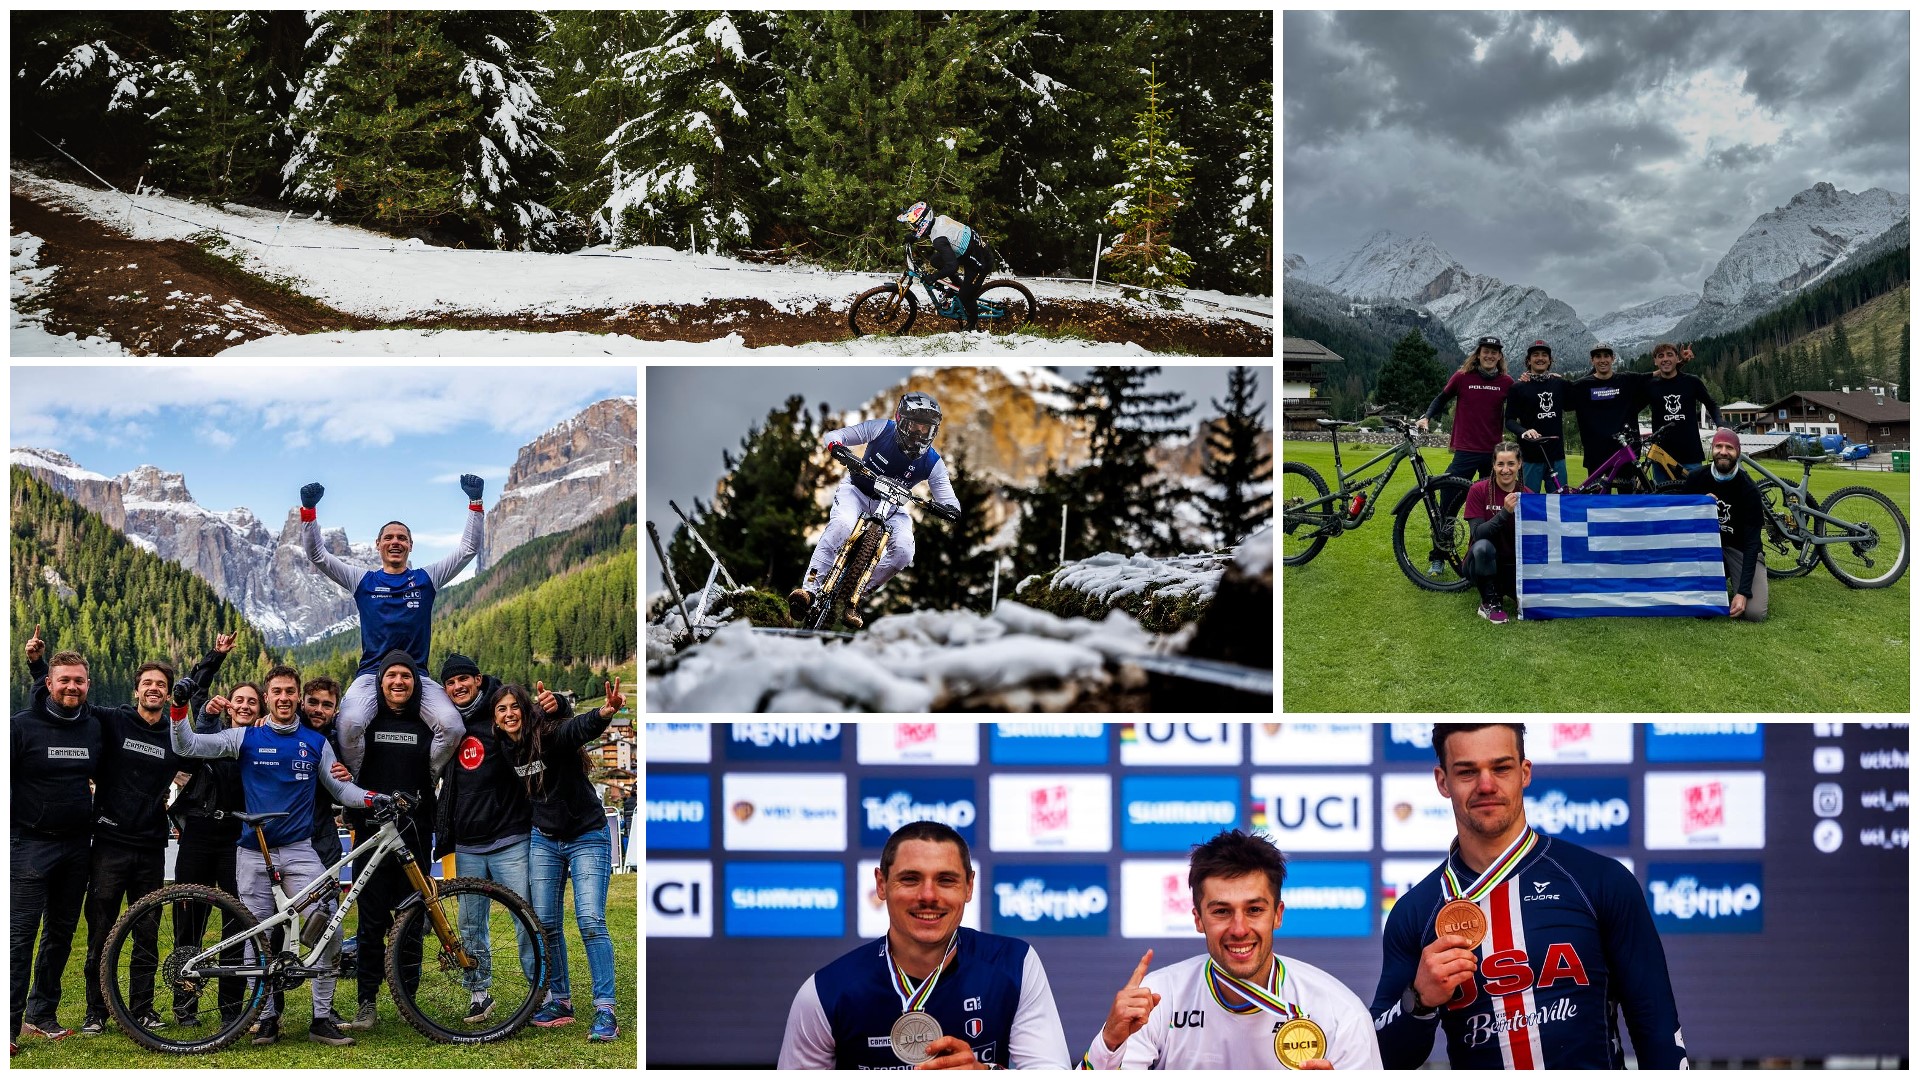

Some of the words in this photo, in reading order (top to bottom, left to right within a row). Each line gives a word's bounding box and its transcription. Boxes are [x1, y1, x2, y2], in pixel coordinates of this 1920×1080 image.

[463, 746, 477, 760] CW
[1276, 796, 1360, 831] UCI
[646, 881, 701, 916] CI
[994, 878, 1109, 922] TRENTINO
[1523, 894, 1561, 902] CUORE
[1648, 874, 1761, 919] TRENTINO
[1452, 920, 1473, 932] UCI
[1174, 1010, 1205, 1028] UCI
[1291, 1040, 1310, 1050] UCI
